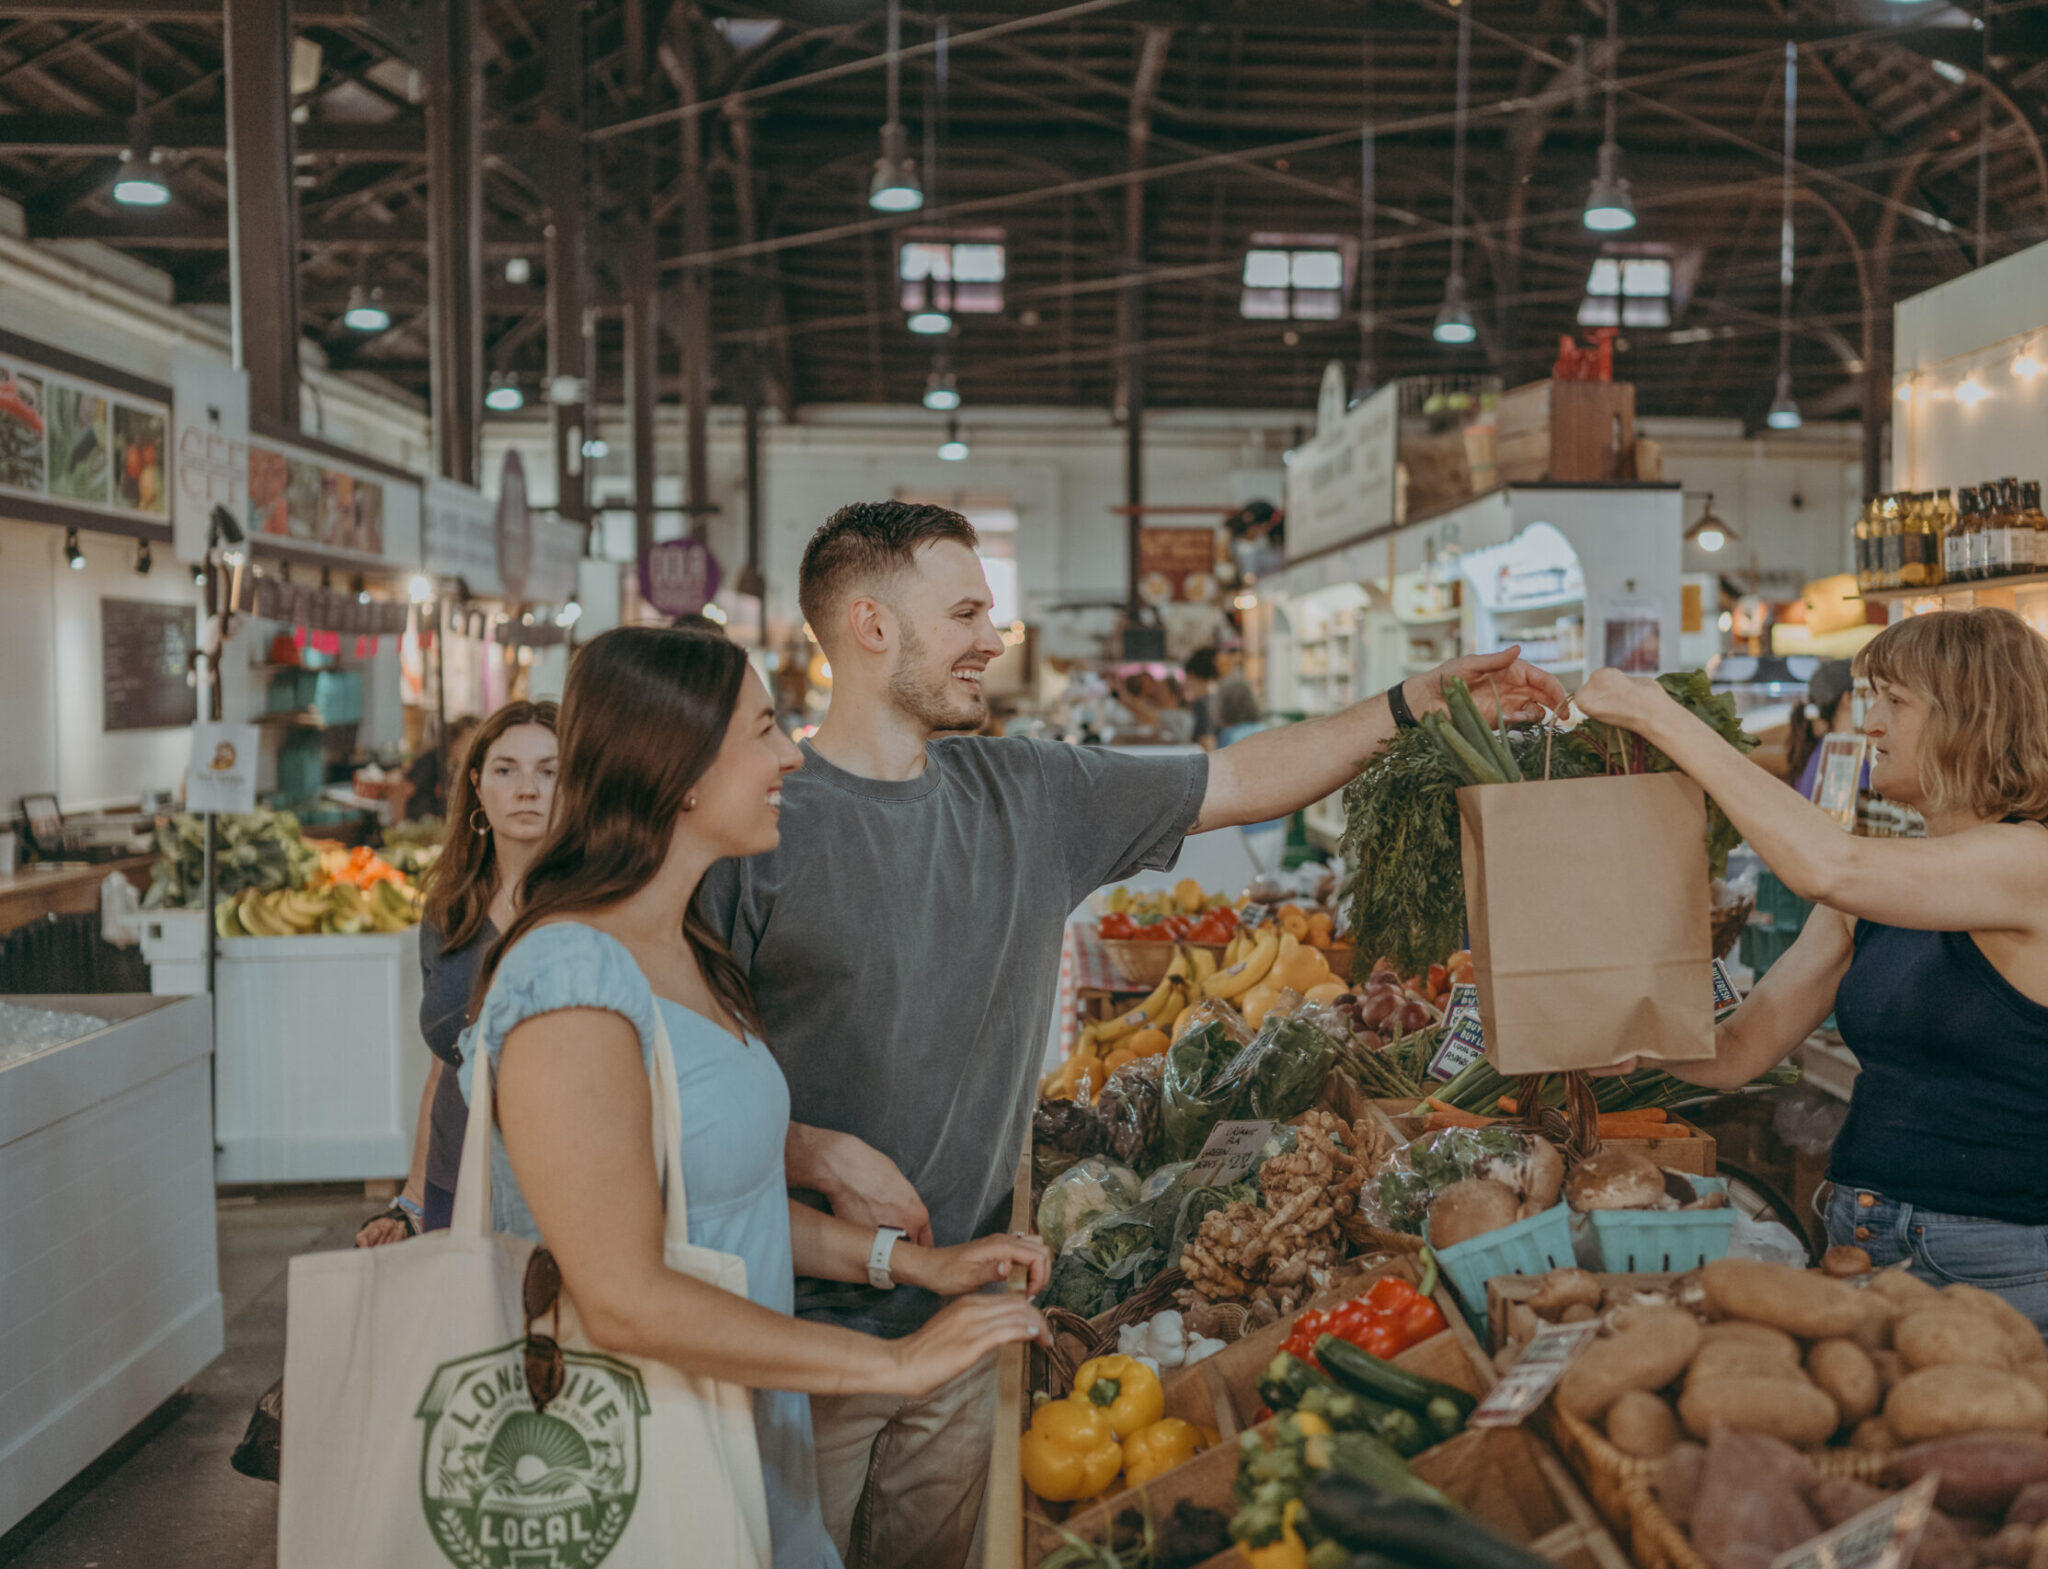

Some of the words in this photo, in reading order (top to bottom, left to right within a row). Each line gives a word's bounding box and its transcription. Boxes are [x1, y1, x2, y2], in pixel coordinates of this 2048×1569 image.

[1460, 1030, 1477, 1043] BUY
[451, 1363, 523, 1431] LONG
[563, 1372, 619, 1428] IVE
[480, 1512, 591, 1547] LOCAL
